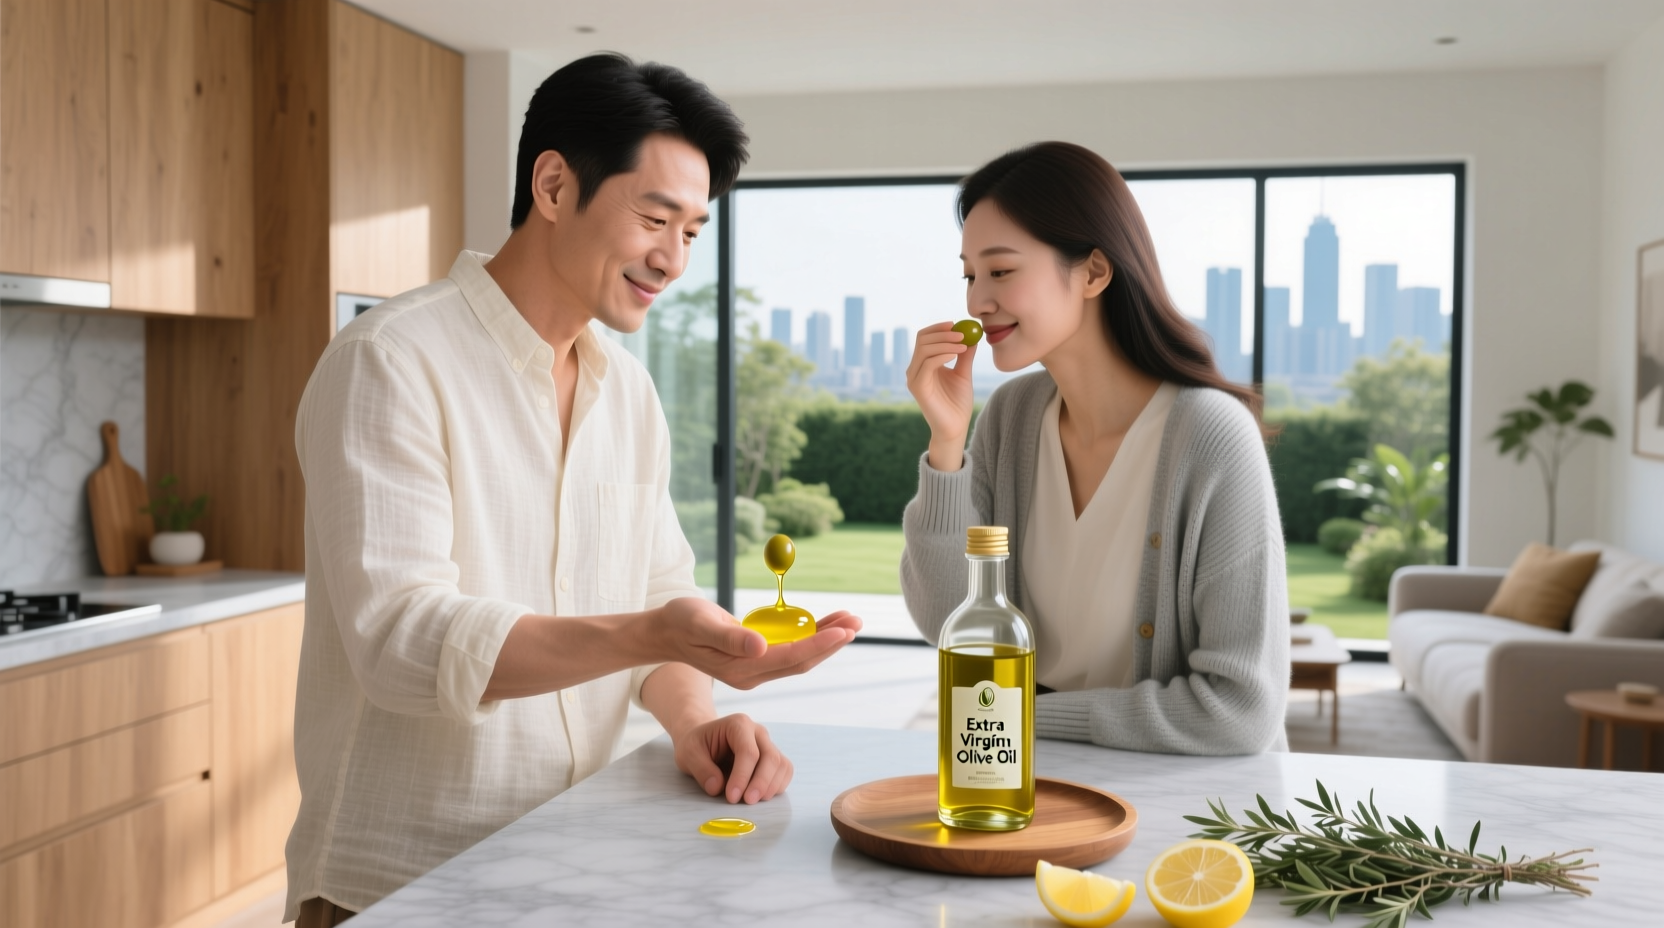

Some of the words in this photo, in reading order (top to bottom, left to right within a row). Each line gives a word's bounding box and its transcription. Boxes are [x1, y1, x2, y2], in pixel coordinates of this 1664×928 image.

[967, 718, 1004, 731] Extra
[957, 749, 993, 764] Olive
[997, 749, 1016, 764] Oil
